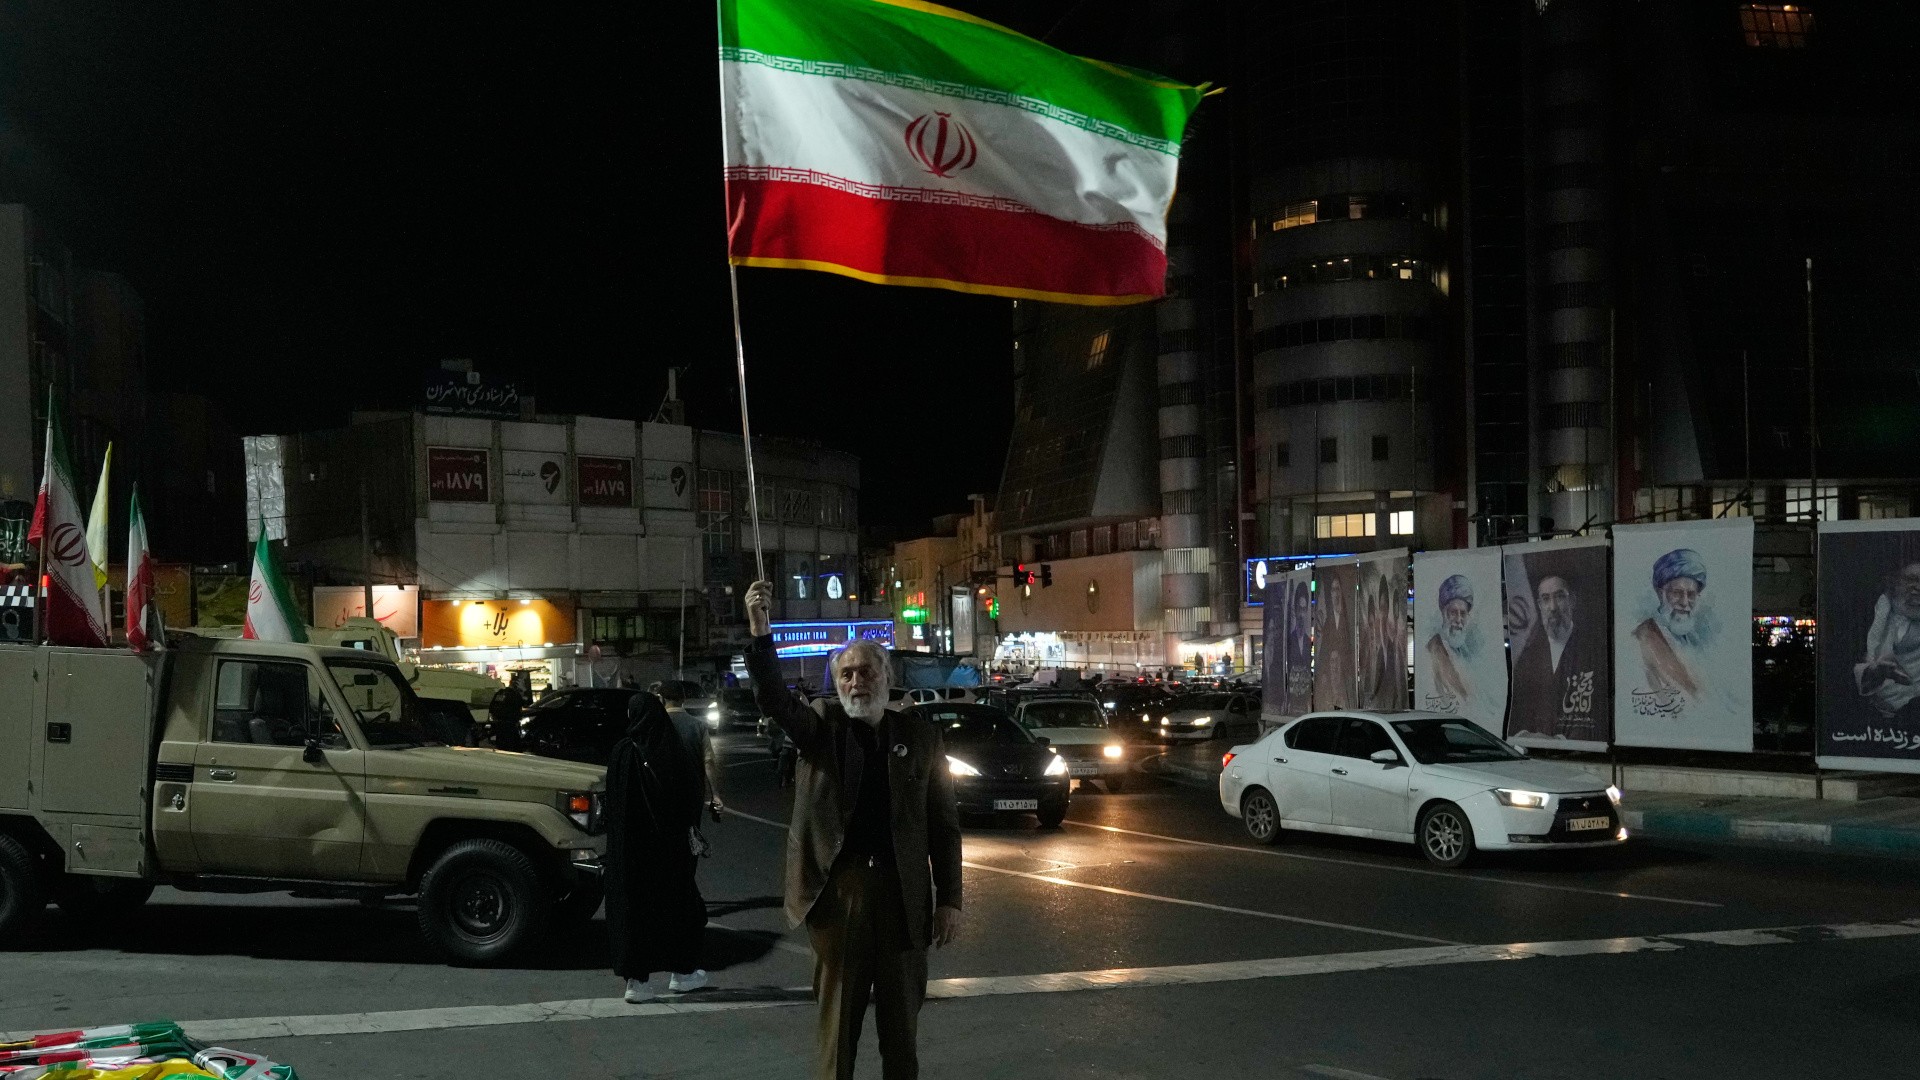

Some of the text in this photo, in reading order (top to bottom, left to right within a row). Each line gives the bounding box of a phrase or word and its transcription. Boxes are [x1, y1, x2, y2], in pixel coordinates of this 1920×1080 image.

[499, 383, 518, 407] دفتر
[784, 631, 811, 641] SADERAT
[813, 631, 827, 640] IRAN
[1832, 725, 1872, 742] است
[1873, 727, 1909, 750] زنده
